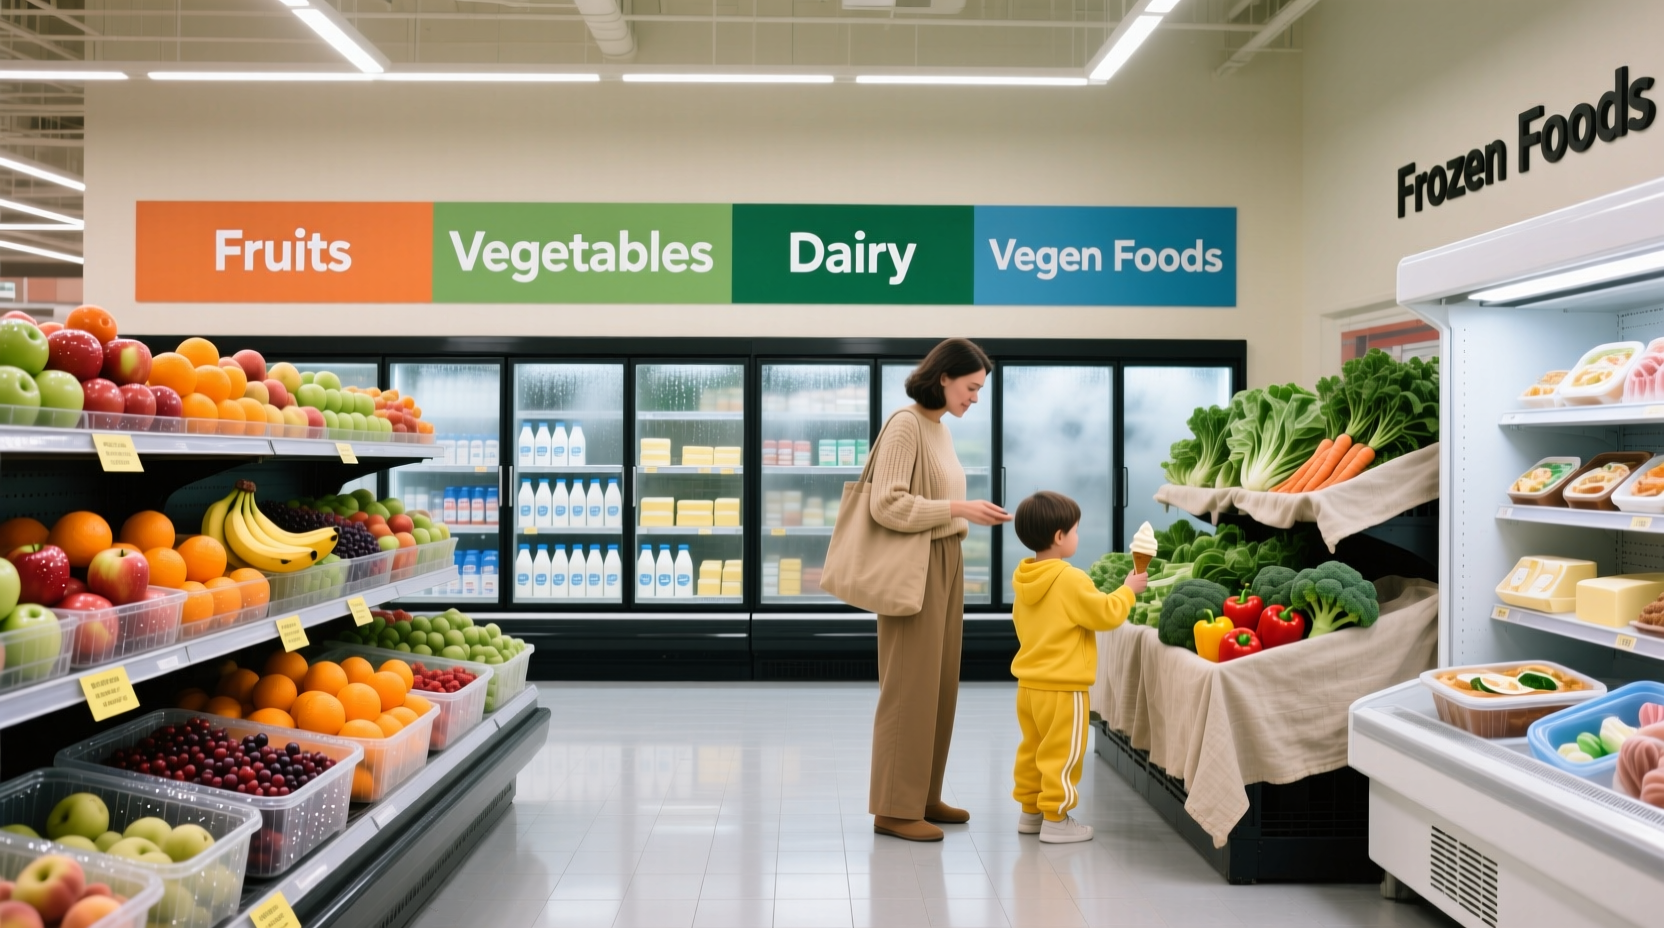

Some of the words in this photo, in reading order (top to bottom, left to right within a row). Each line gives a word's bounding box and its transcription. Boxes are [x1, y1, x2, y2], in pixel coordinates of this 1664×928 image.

[1398, 139, 1507, 219] Frozen
[1518, 65, 1657, 174] Foods
[215, 227, 352, 273] Fruits
[448, 229, 714, 283] Vegetables
[790, 230, 917, 285] Dairy
[988, 238, 1102, 280] Vegen
[1114, 239, 1223, 272] Foods
